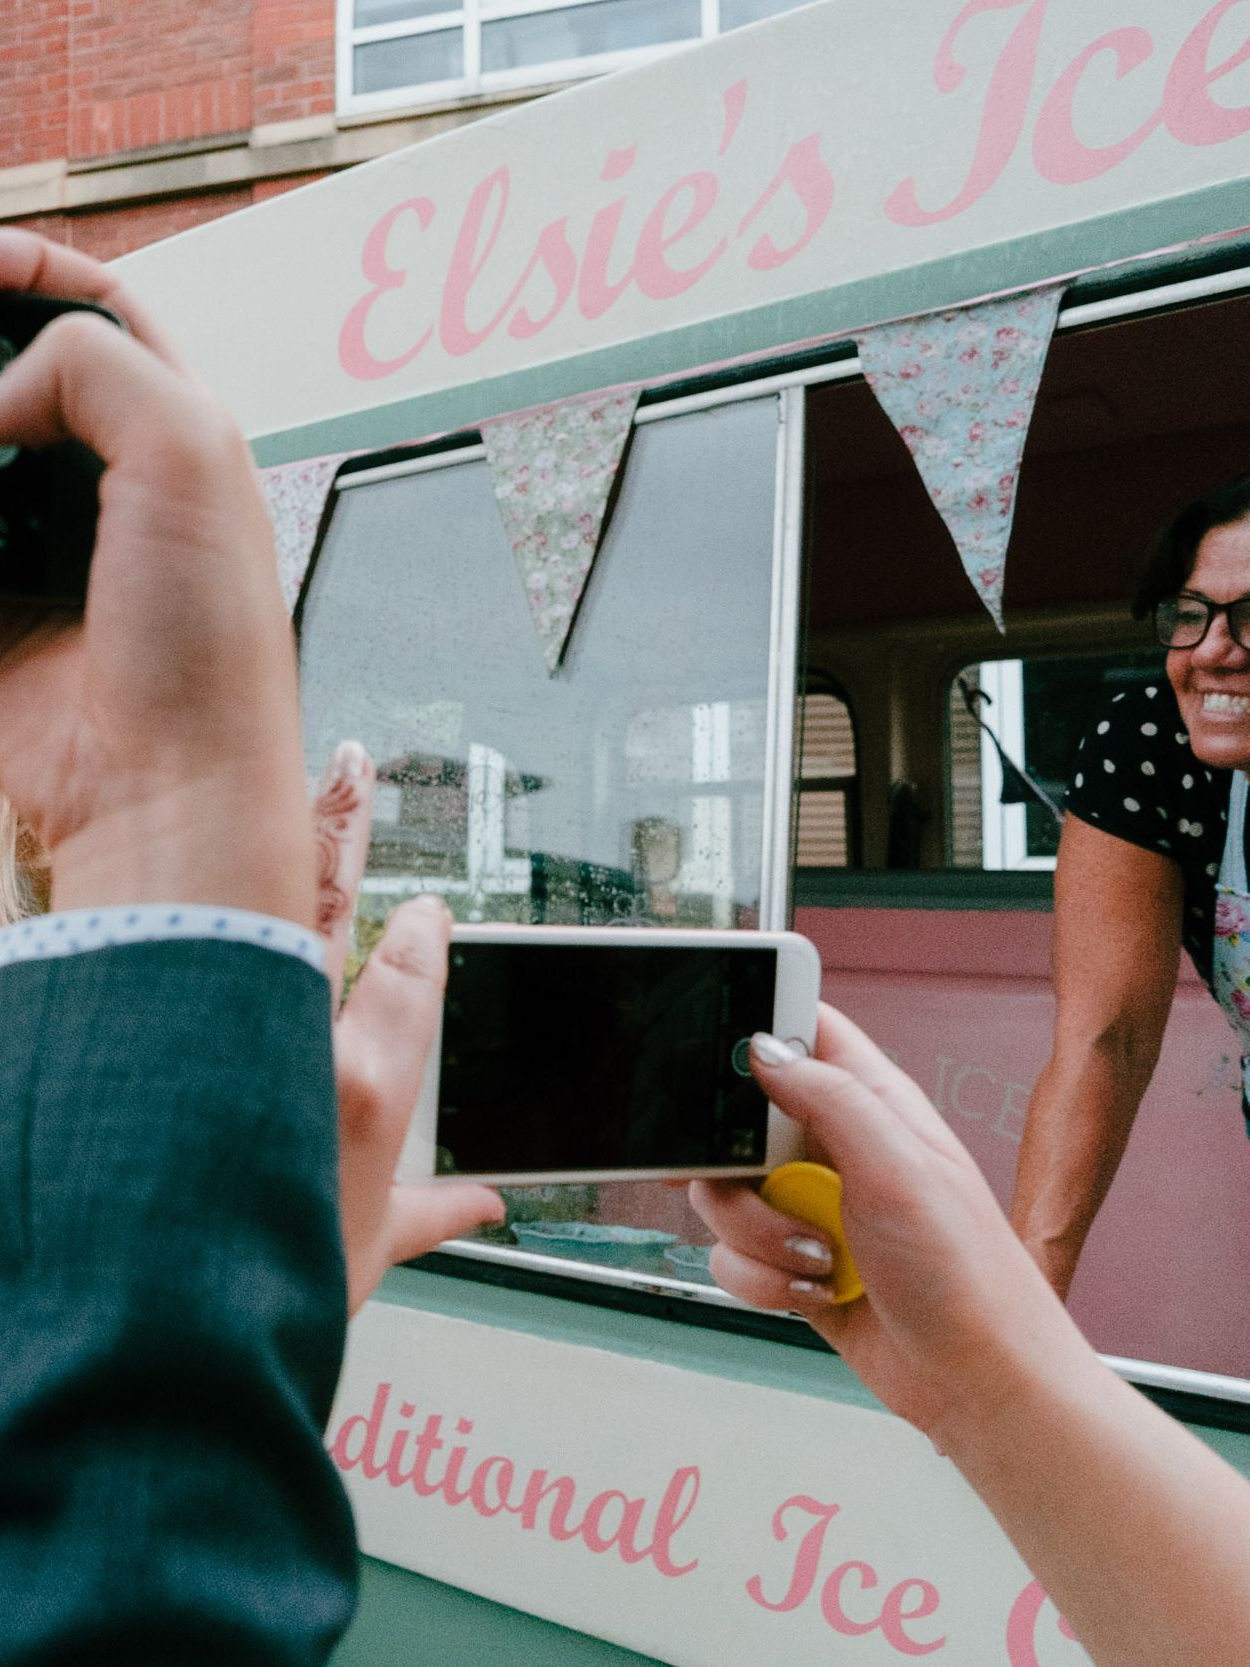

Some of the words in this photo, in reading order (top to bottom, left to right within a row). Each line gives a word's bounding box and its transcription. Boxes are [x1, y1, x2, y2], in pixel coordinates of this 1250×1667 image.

[338, 77, 834, 380] Elsie's
[882, 0, 1250, 228] Ice
[327, 1383, 701, 1578] ditional
[745, 1495, 946, 1655] Ice
